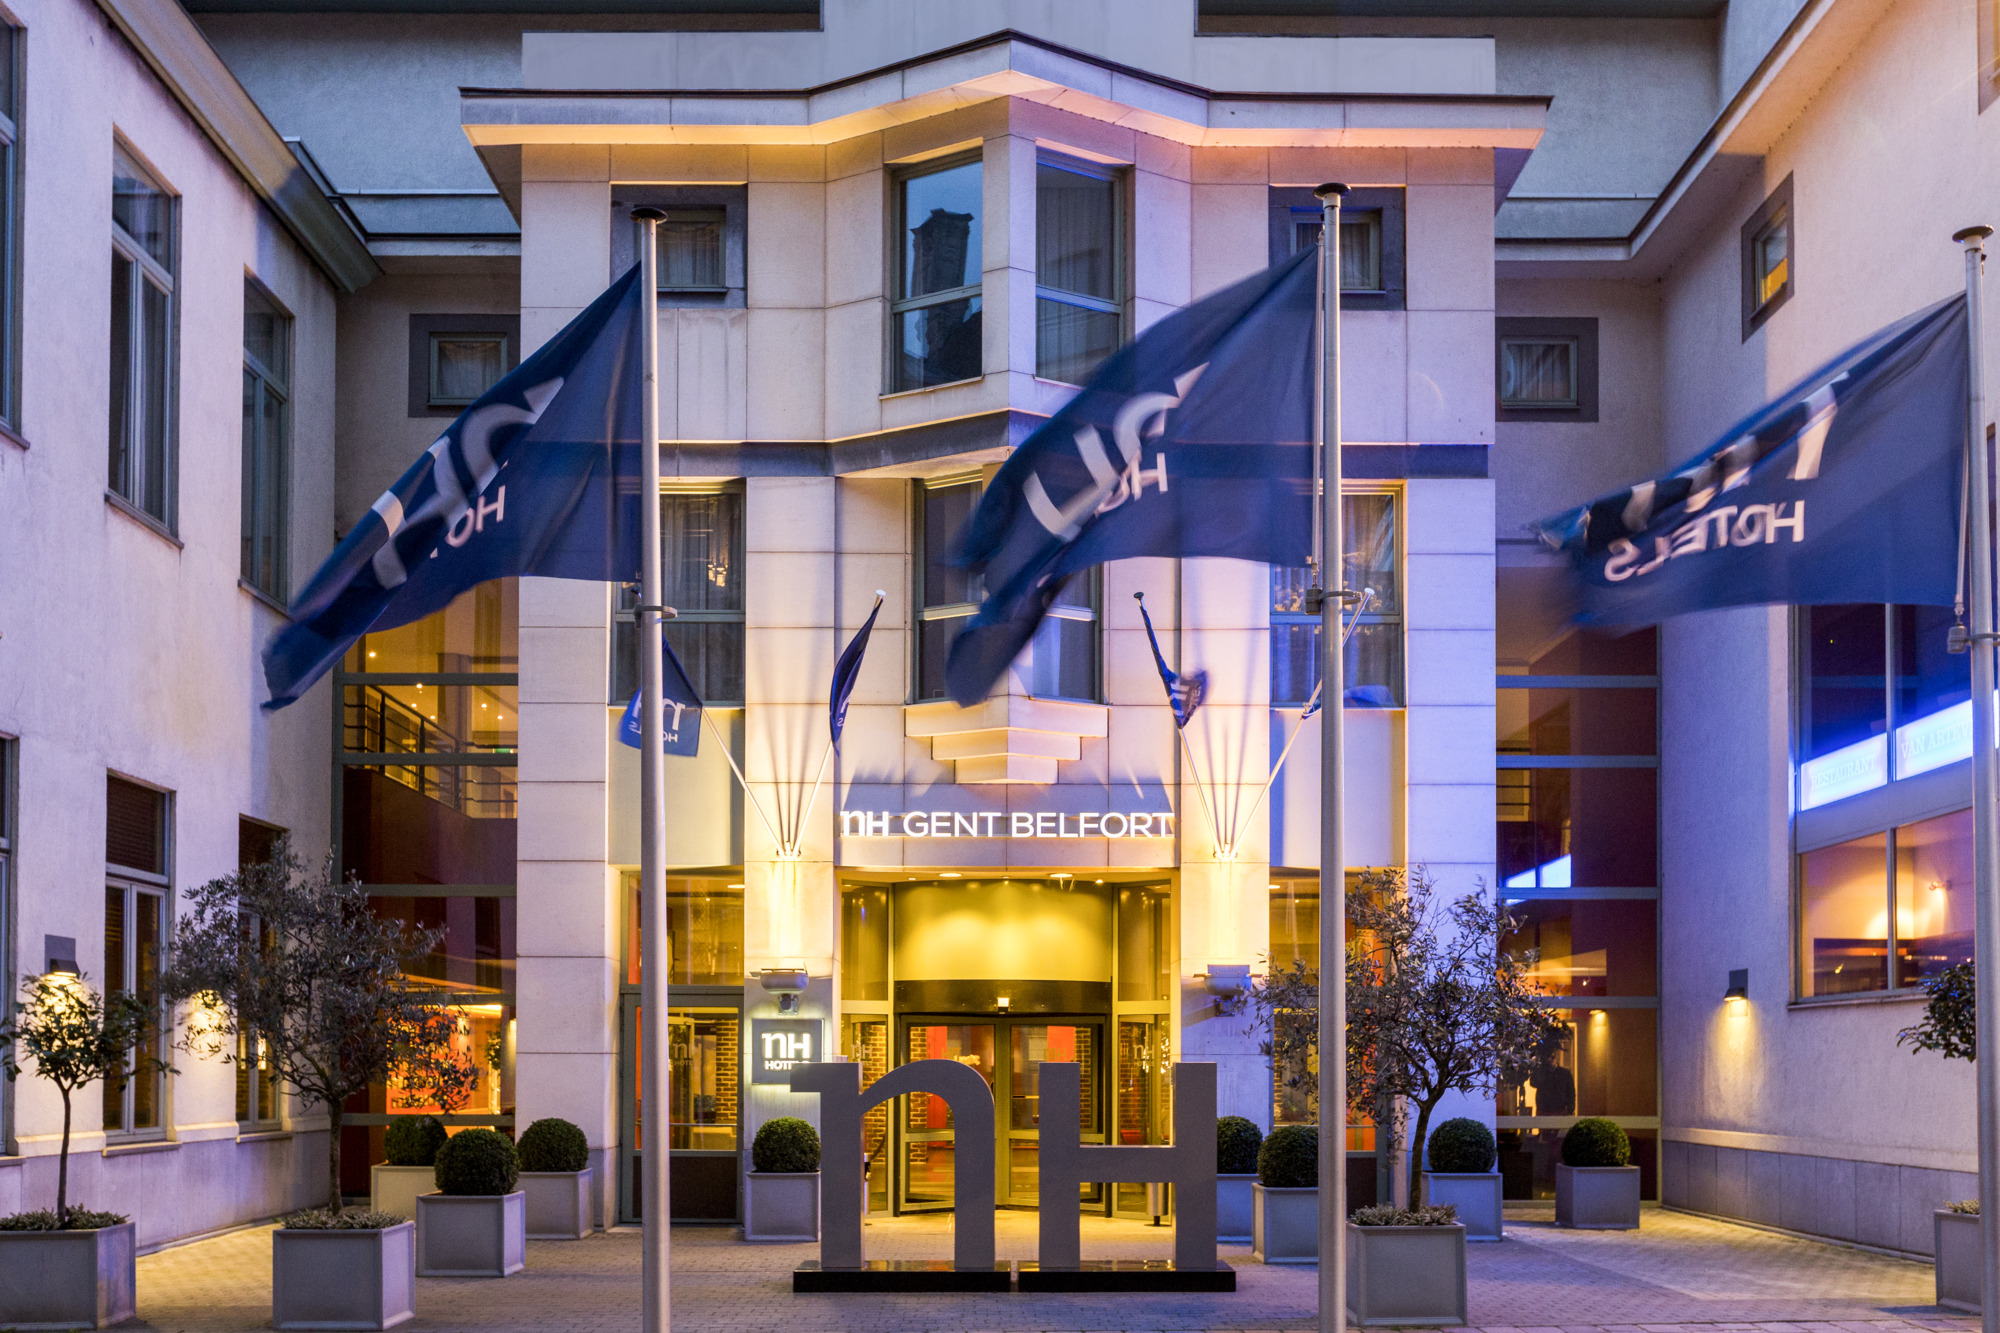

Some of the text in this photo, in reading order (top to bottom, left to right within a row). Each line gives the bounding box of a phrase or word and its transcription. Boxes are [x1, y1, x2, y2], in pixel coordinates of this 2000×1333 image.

[1900, 719, 1972, 759] VAN ARTEV
[1811, 754, 1877, 790] RESTAURANT
[903, 811, 1002, 838] GENT
[1011, 811, 1175, 838] BELFORT
[764, 1060, 809, 1070] HOT
